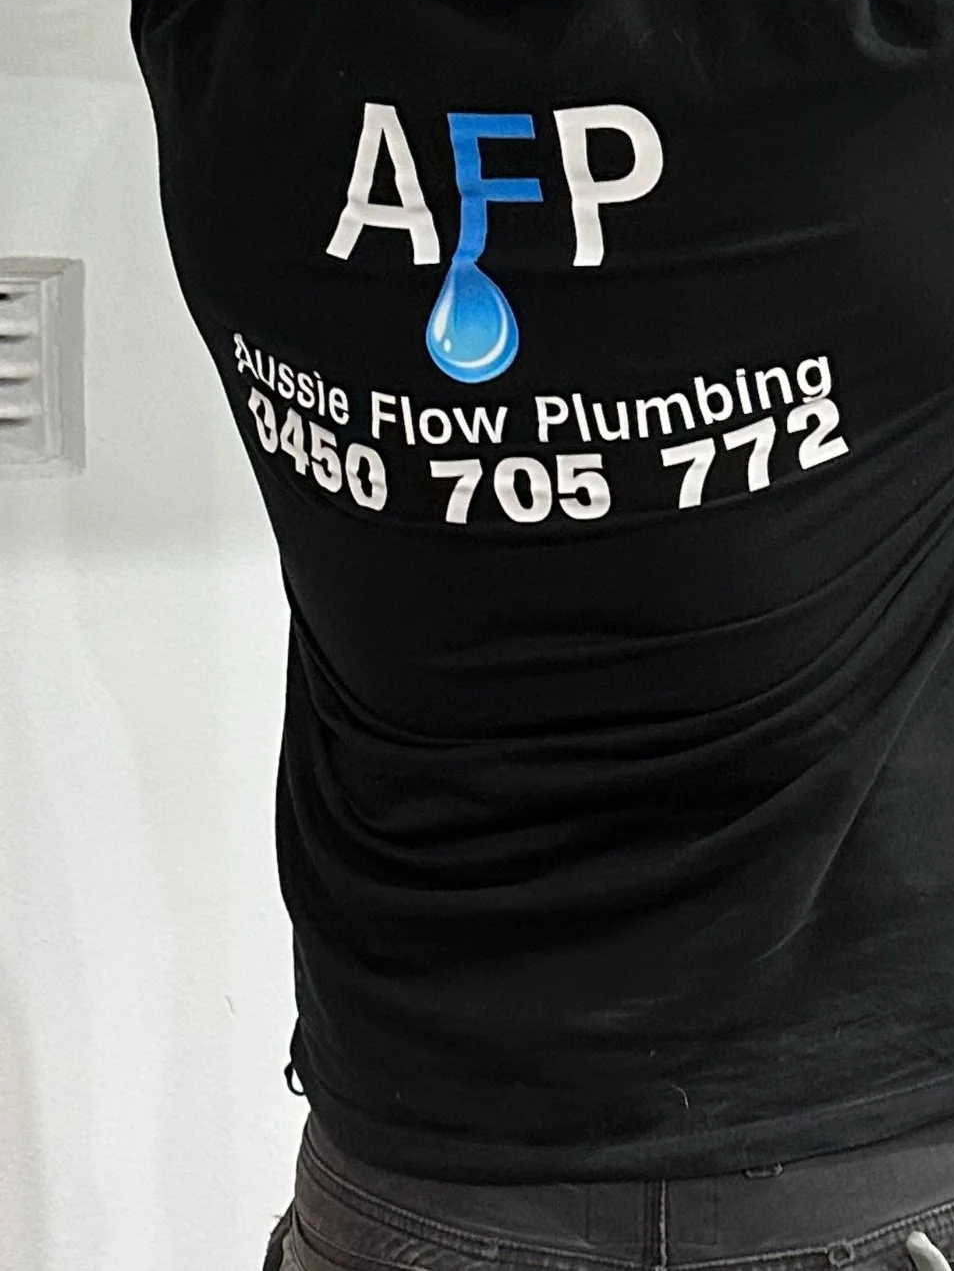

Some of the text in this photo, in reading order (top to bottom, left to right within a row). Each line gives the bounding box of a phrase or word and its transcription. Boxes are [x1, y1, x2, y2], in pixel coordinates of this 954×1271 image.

[325, 102, 664, 267] AFP
[233, 332, 832, 446] Aussie Flow Plumbing
[247, 385, 850, 524] 0450 705 772
